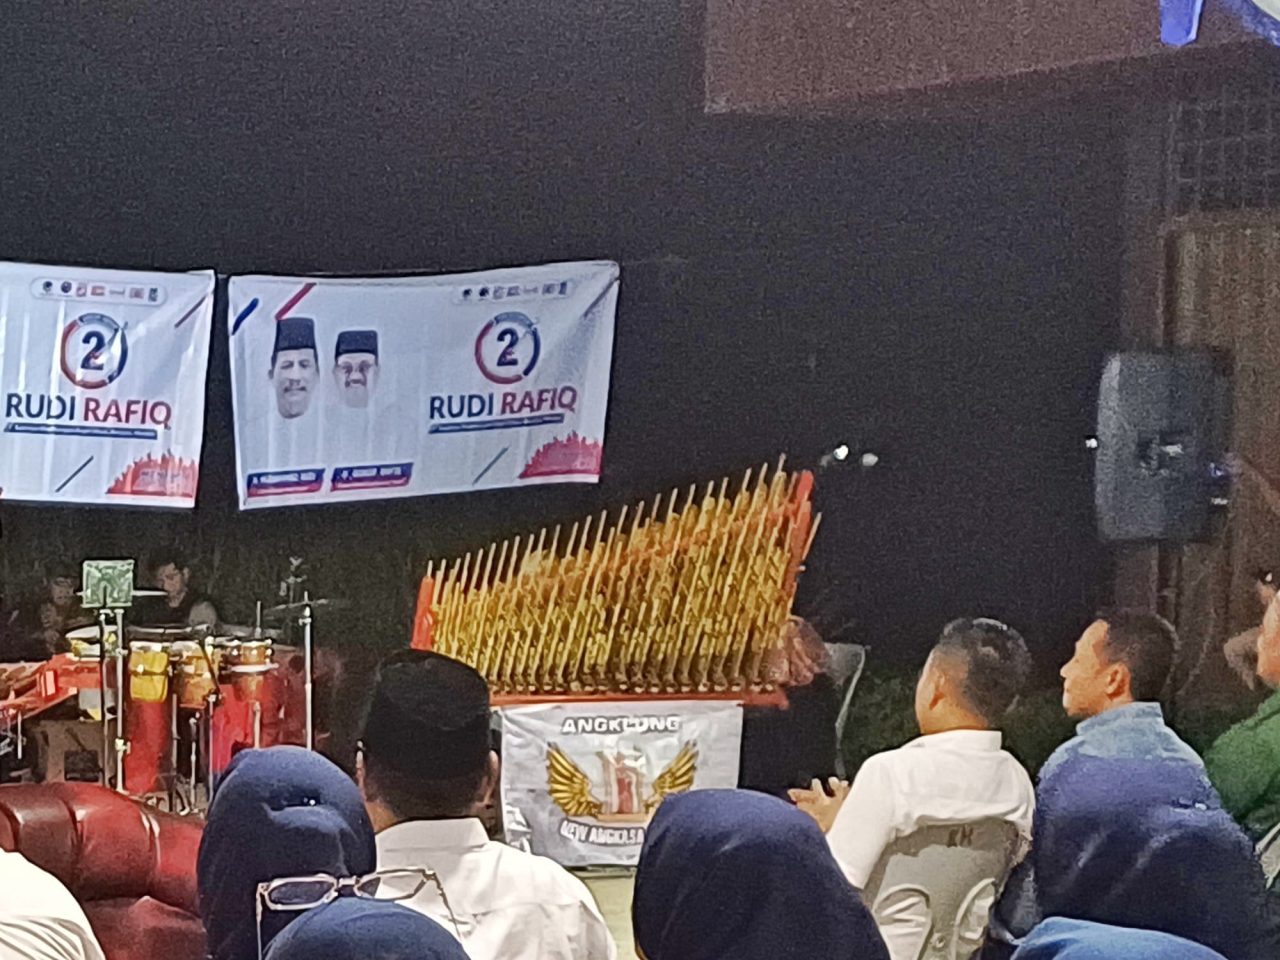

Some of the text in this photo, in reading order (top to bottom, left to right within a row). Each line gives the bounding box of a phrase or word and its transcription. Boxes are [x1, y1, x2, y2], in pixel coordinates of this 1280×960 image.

[81, 330, 105, 370] 2
[497, 328, 519, 366] 2
[5, 393, 172, 430] RUDI RAFIQ
[429, 385, 578, 420] RUDI RAFIQ
